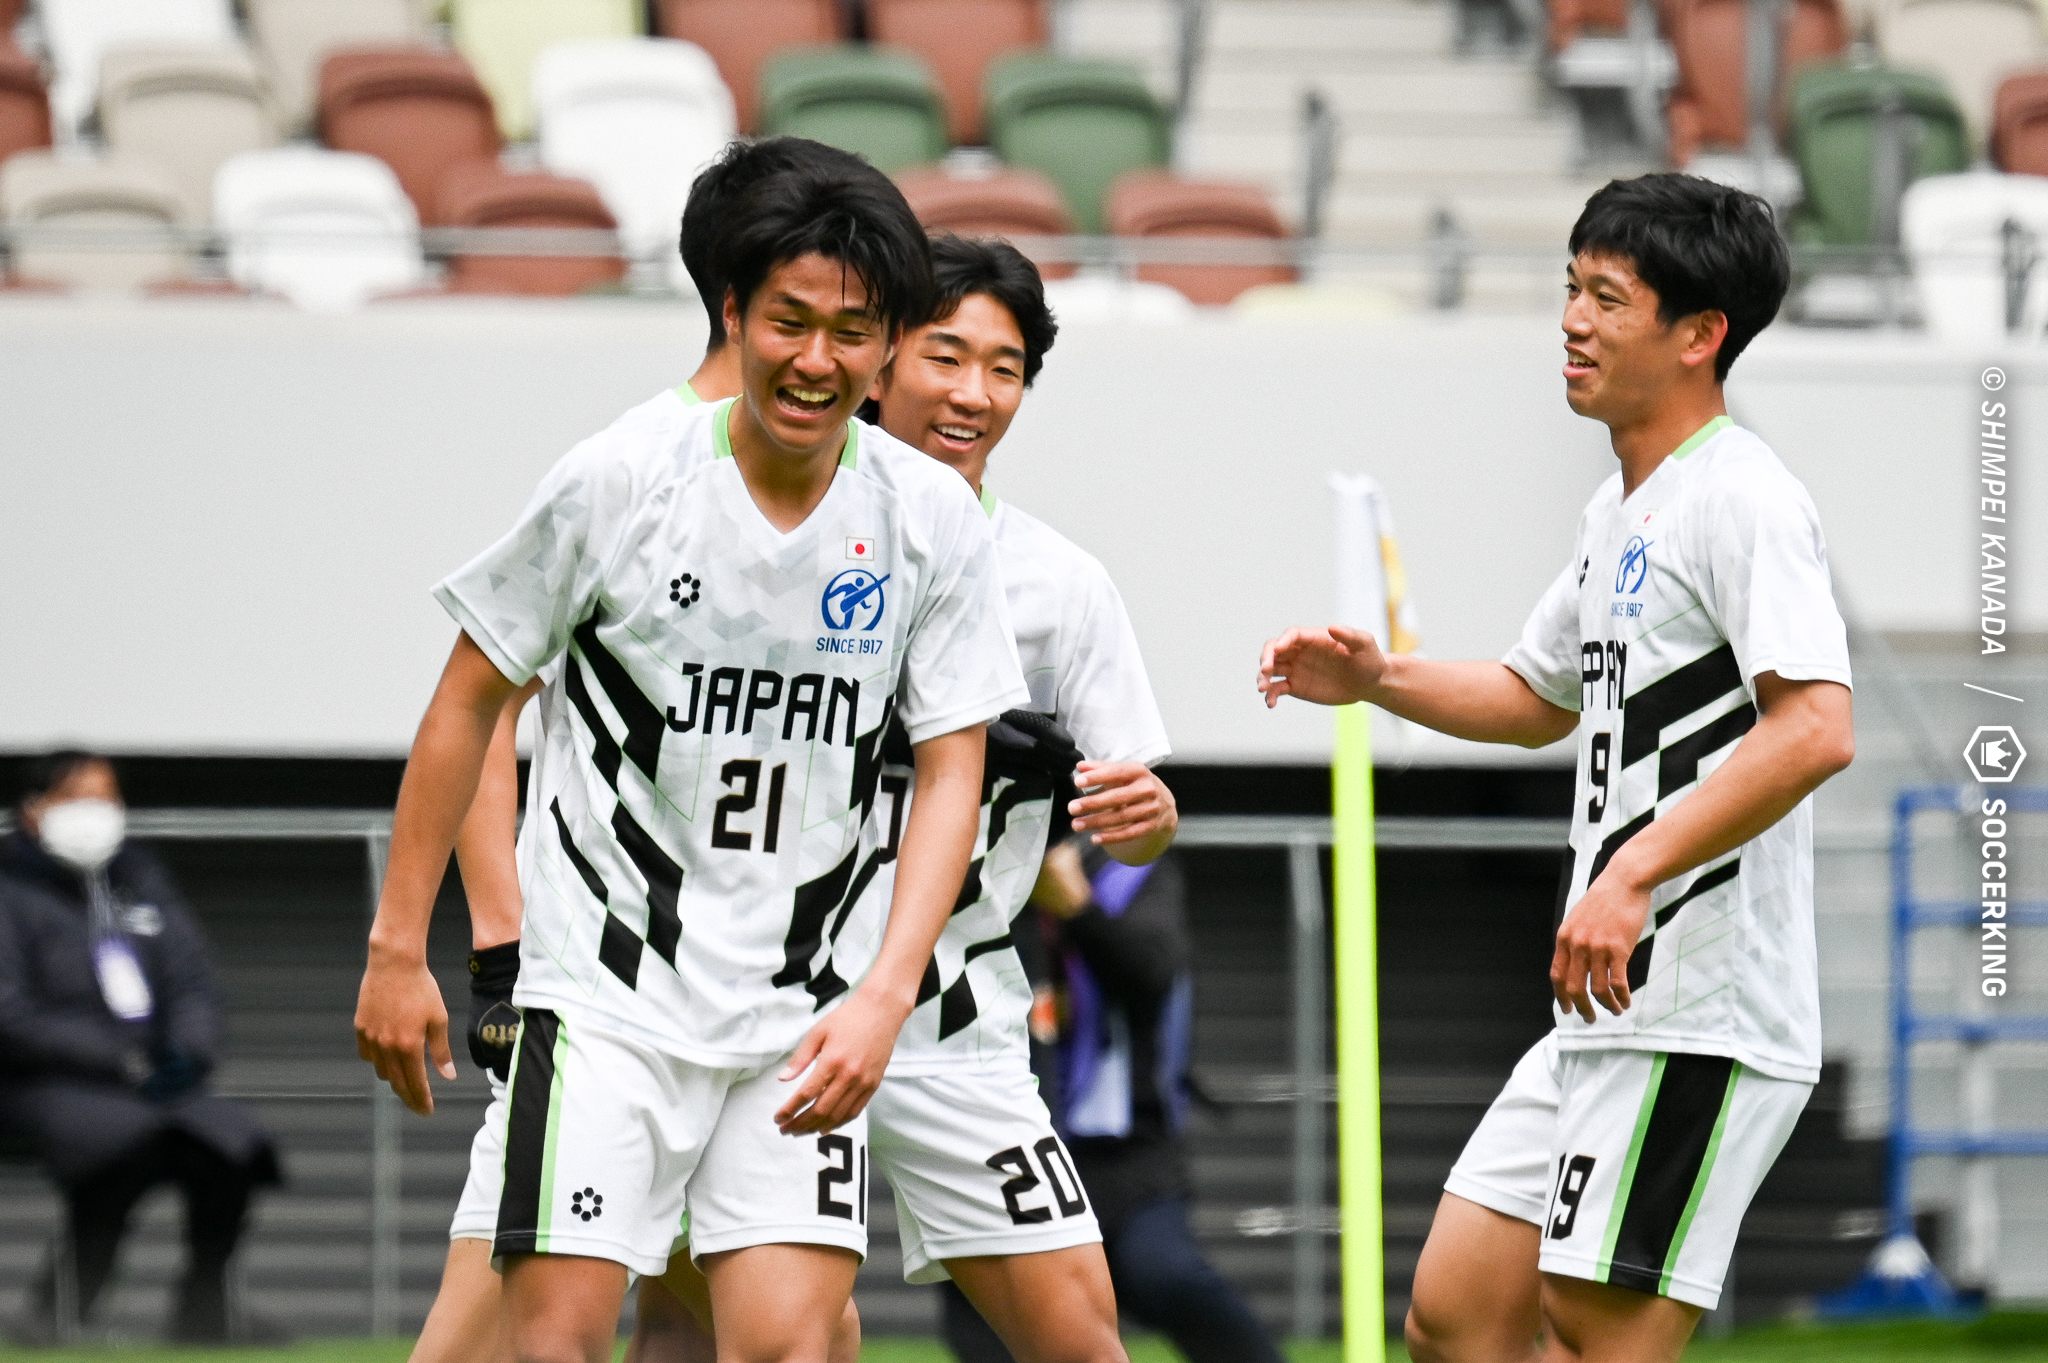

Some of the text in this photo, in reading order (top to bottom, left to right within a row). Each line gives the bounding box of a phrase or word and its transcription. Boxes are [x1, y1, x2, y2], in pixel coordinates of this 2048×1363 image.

[815, 636, 883, 655] SINCE 1917
[1626, 602, 1644, 618] 1917
[666, 662, 860, 747] JAPAN
[711, 759, 787, 854] 21
[817, 1133, 867, 1226] 21
[986, 1136, 1087, 1225] 20
